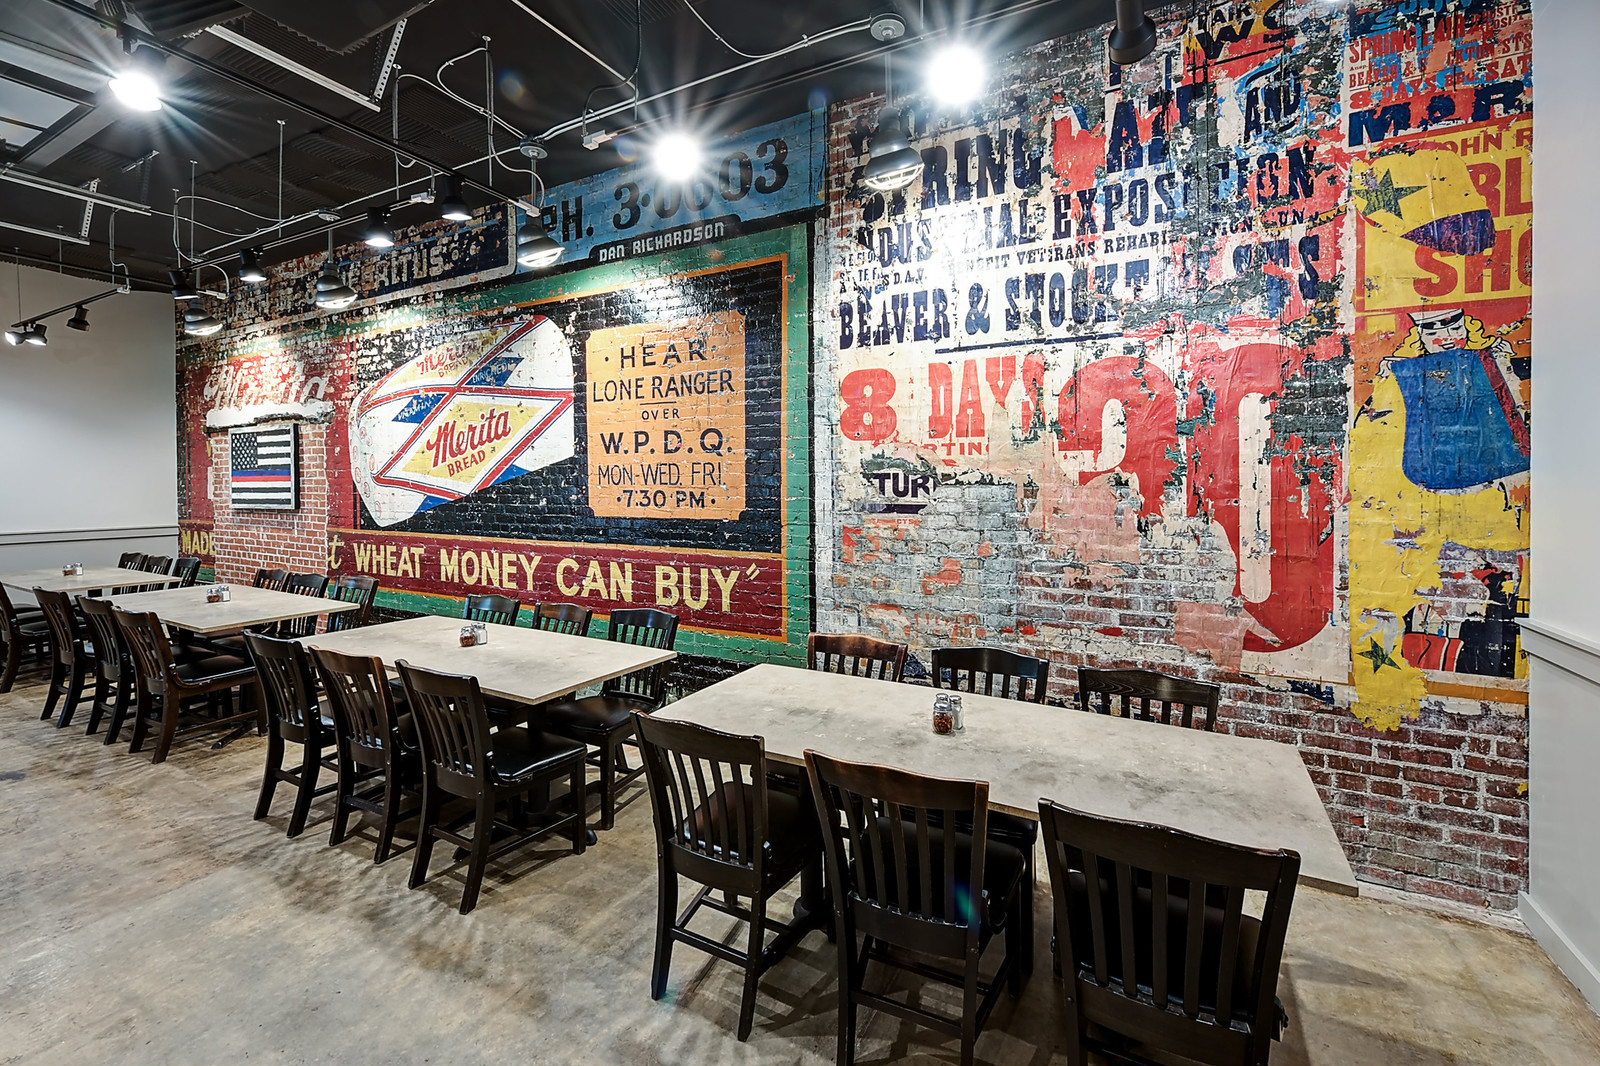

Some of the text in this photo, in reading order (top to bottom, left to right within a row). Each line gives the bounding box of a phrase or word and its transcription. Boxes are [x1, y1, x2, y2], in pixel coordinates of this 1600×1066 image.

[1349, 26, 1416, 63] SPRING
[1349, 64, 1398, 88] BEAVER
[1349, 90, 1373, 110] 8
[1381, 75, 1438, 102] DAYS
[599, 221, 725, 263] DAN RICHARDSON
[1016, 238, 1097, 267] VETERANS
[838, 287, 951, 350] BEAVER
[964, 282, 991, 335] &
[620, 336, 708, 369] HEAR
[593, 369, 735, 403] LONE RANGER
[839, 352, 1047, 442] 8 DAYS
[641, 408, 680, 421] OVER
[426, 408, 512, 468] Merita
[447, 449, 486, 478] BREAD
[676, 490, 705, 509] PM
[181, 529, 215, 556] MADE
[353, 543, 425, 579] WHEAT
[439, 548, 542, 591] MONEY
[556, 558, 633, 603] CAN
